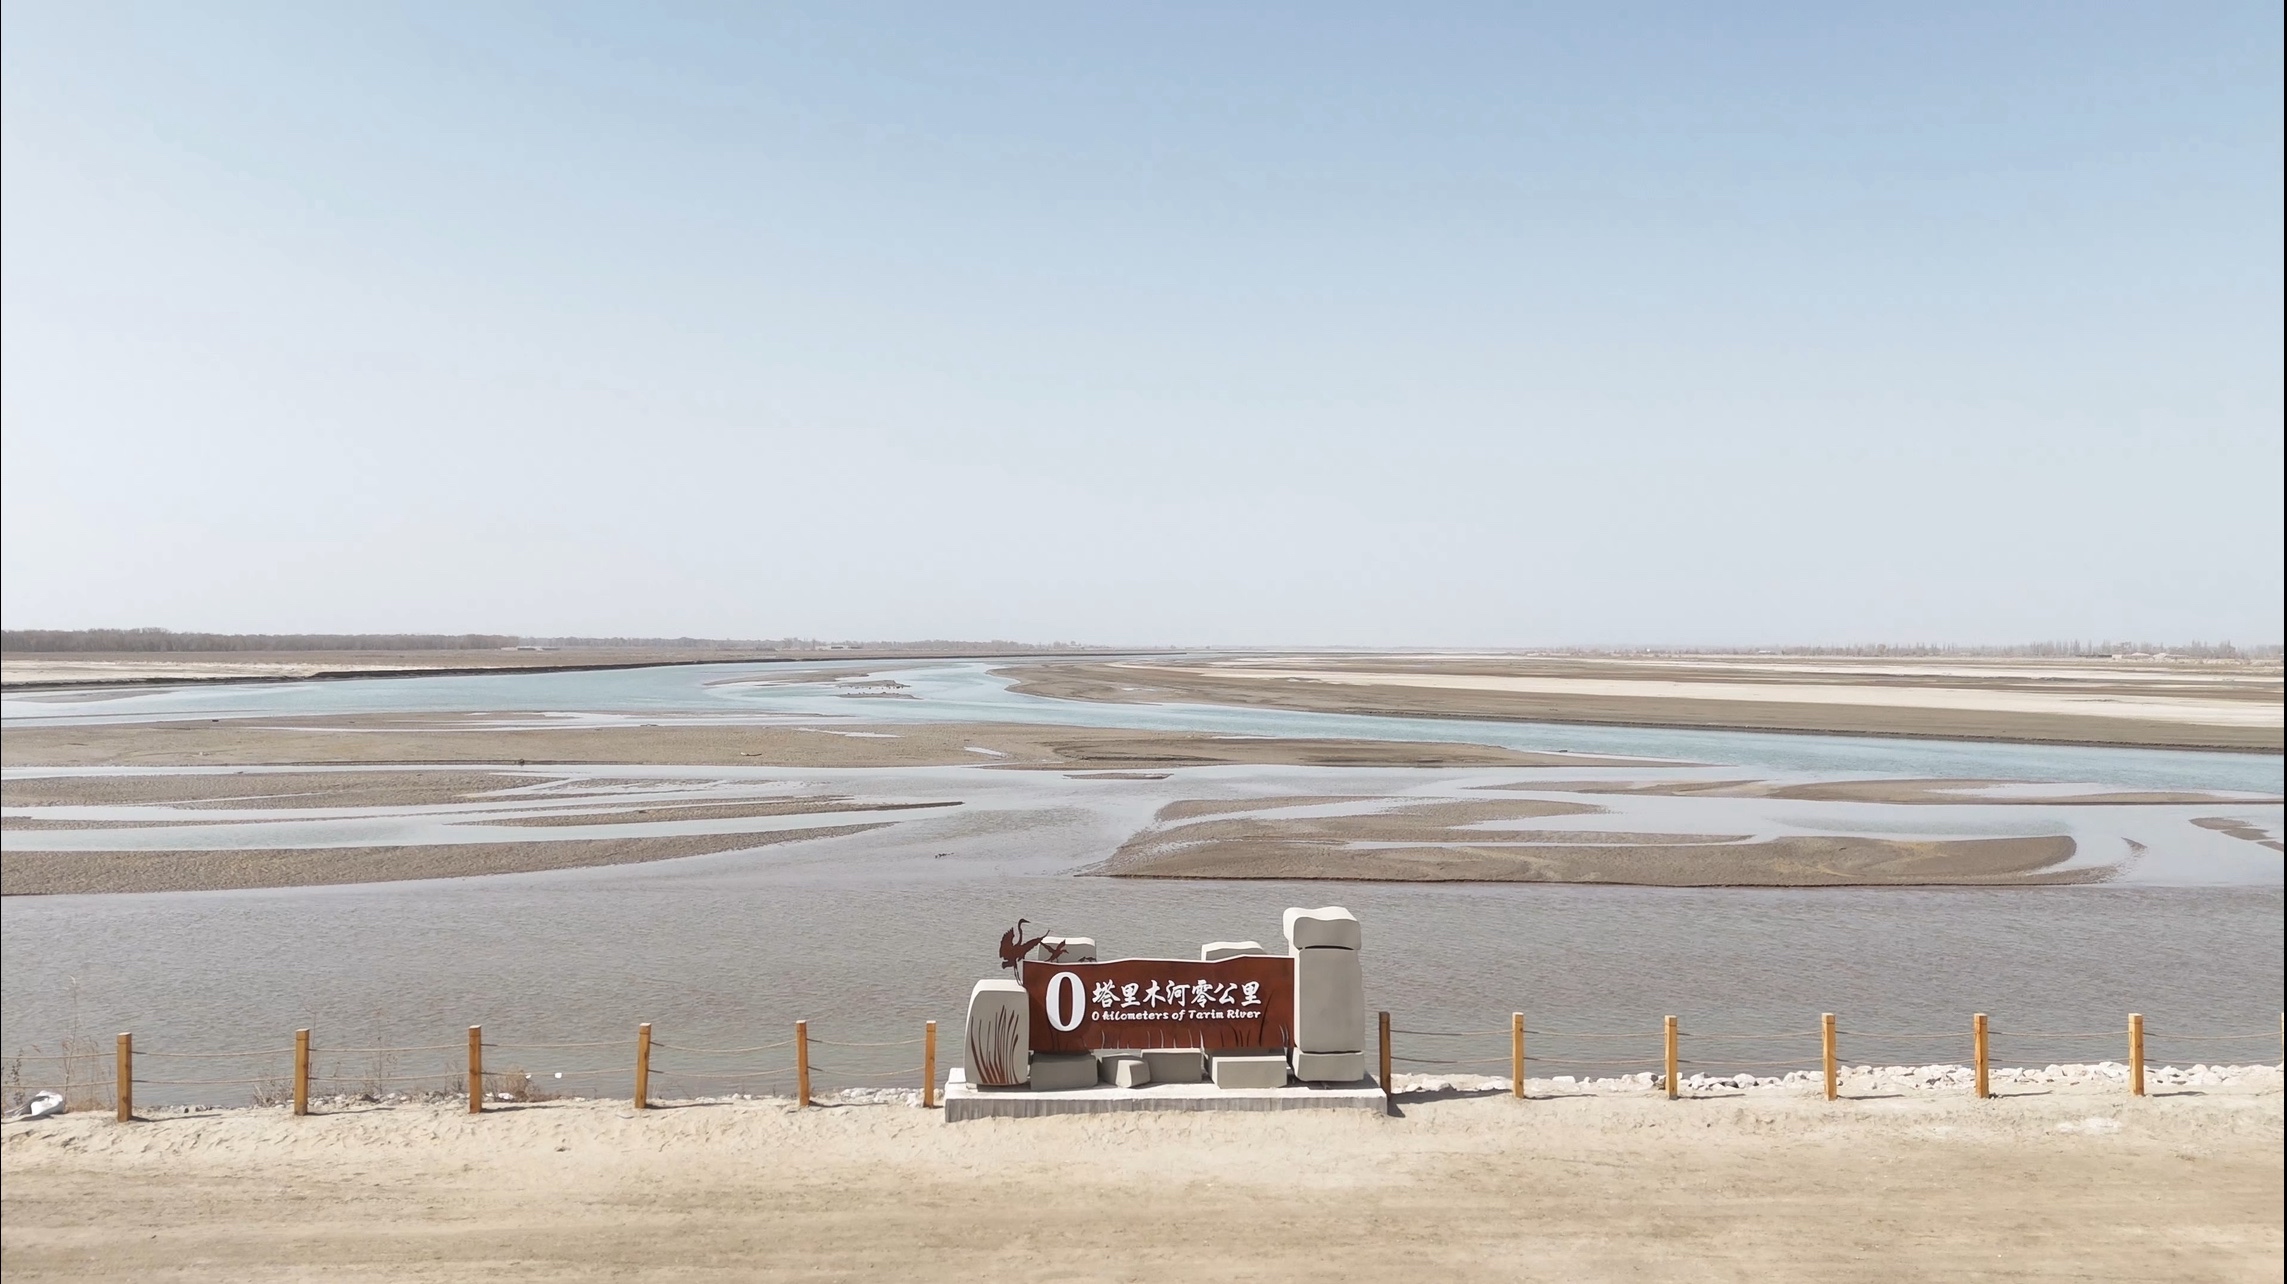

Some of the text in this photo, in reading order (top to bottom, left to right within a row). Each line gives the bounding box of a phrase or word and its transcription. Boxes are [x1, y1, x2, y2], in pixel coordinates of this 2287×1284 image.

[1045, 971, 1086, 1032] 0
[1091, 979, 1262, 1009] 塔里木河零公里
[1091, 1008, 1262, 1021] 0 kilometers of Tarim River
